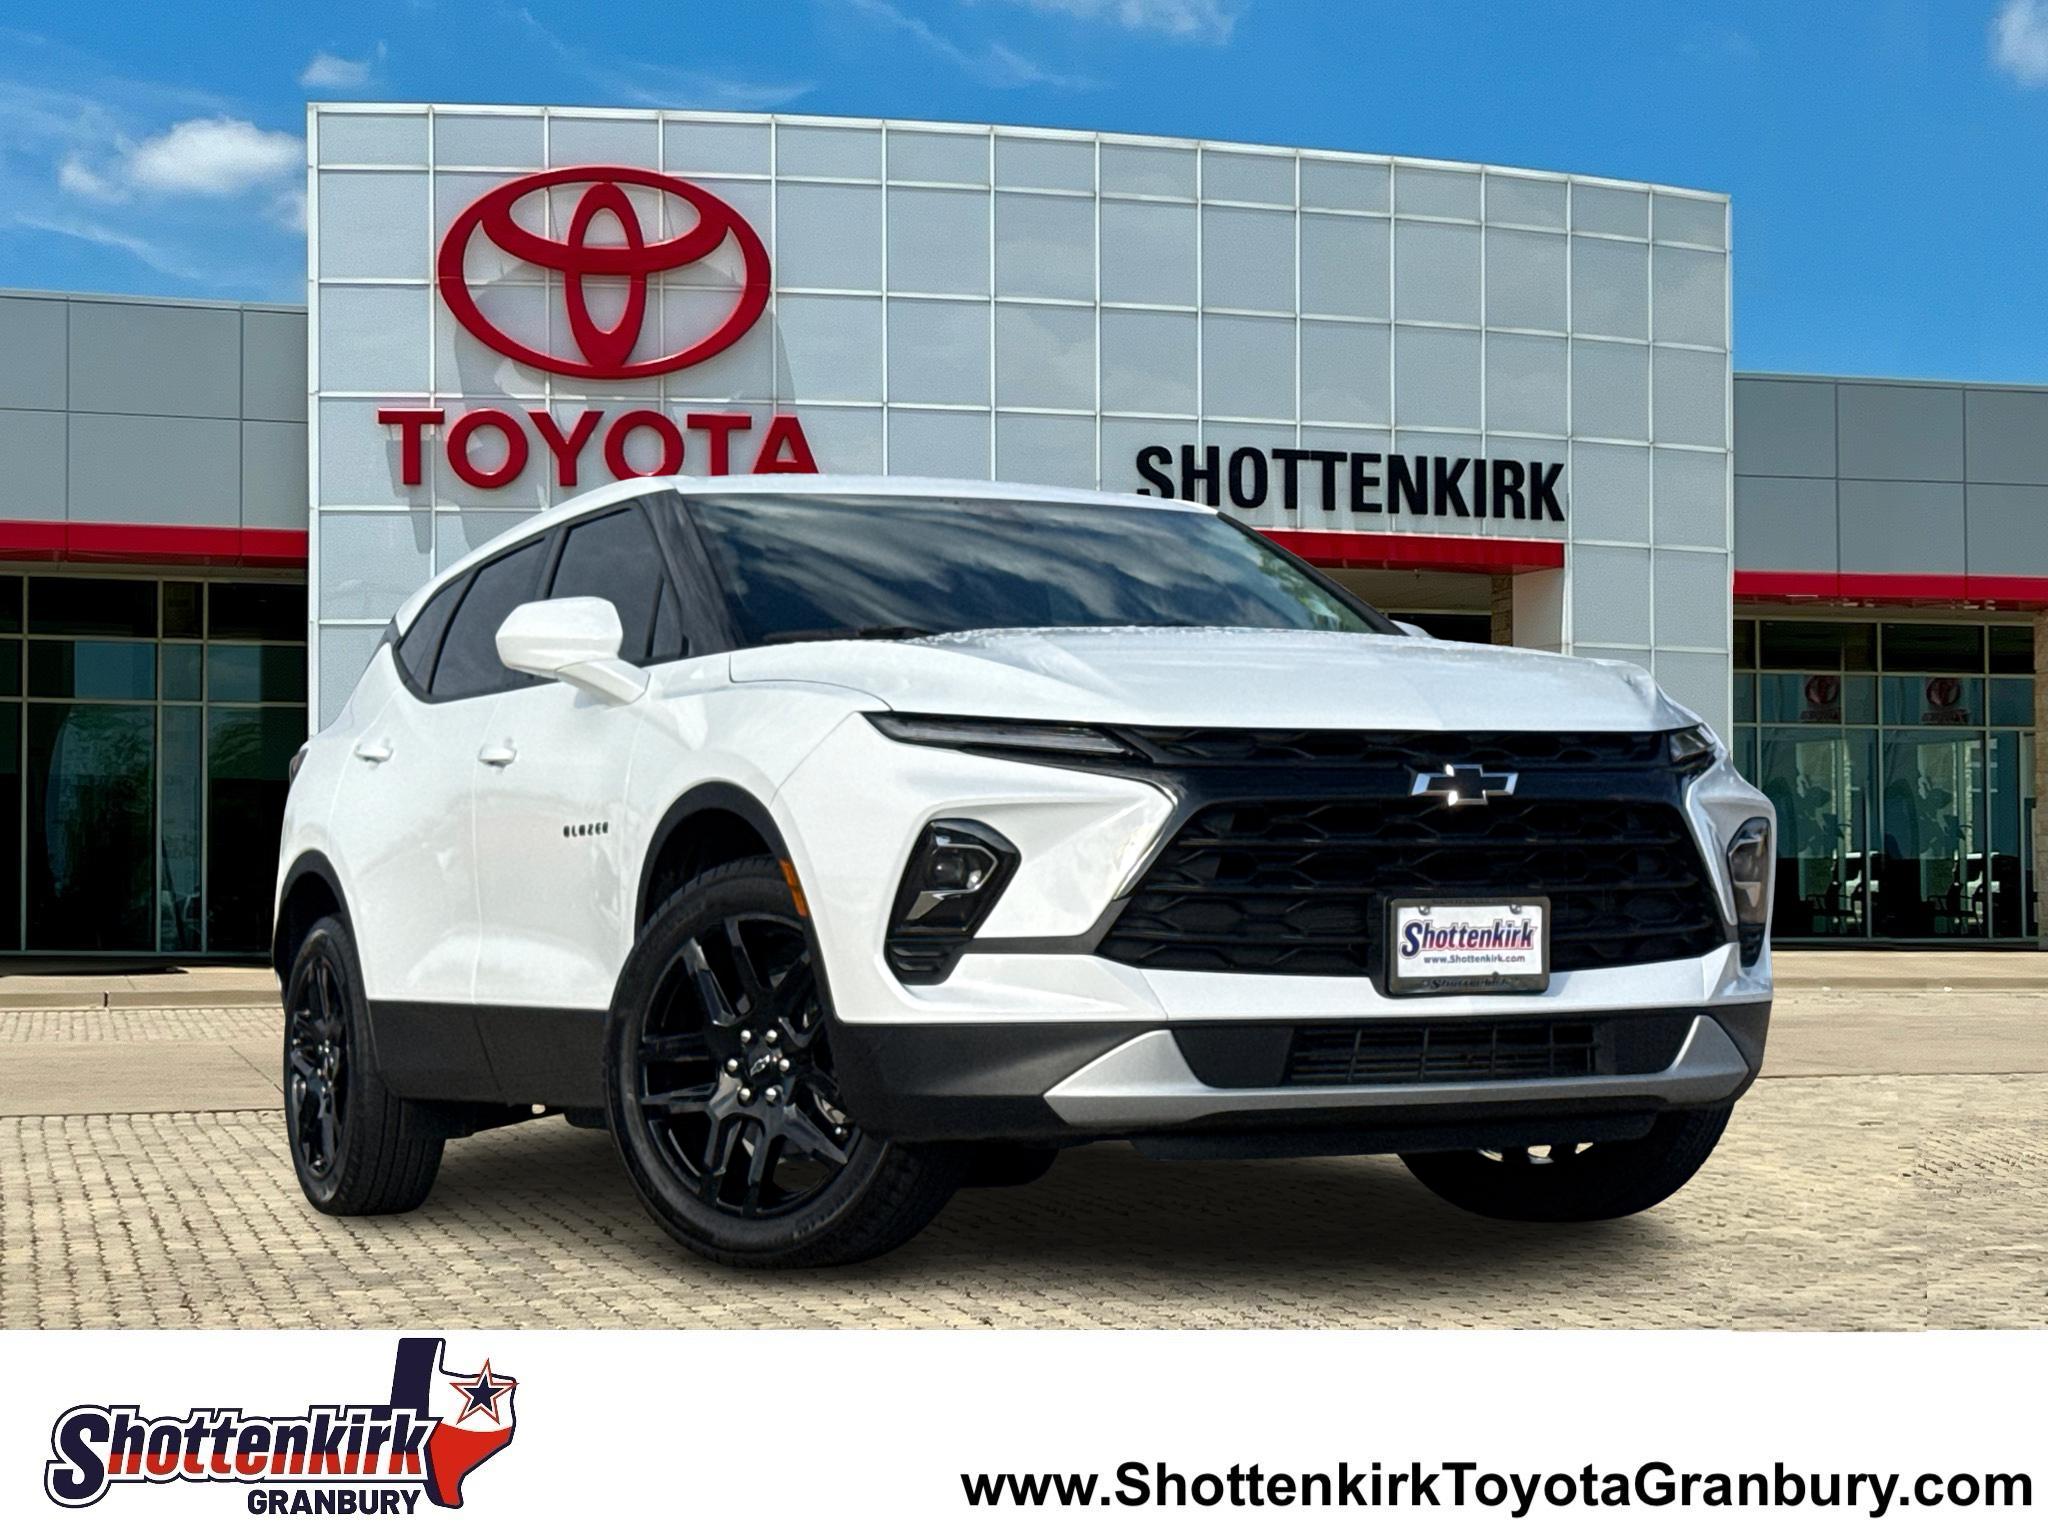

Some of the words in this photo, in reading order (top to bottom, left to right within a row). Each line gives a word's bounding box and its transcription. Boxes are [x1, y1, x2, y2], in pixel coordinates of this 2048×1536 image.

[378, 408, 820, 489] TOYOTA
[1136, 445, 1565, 522] SHOTTENKIRK
[1400, 919, 1536, 958] Shottenkirk
[1423, 954, 1526, 964] www.Shottenkirk.com
